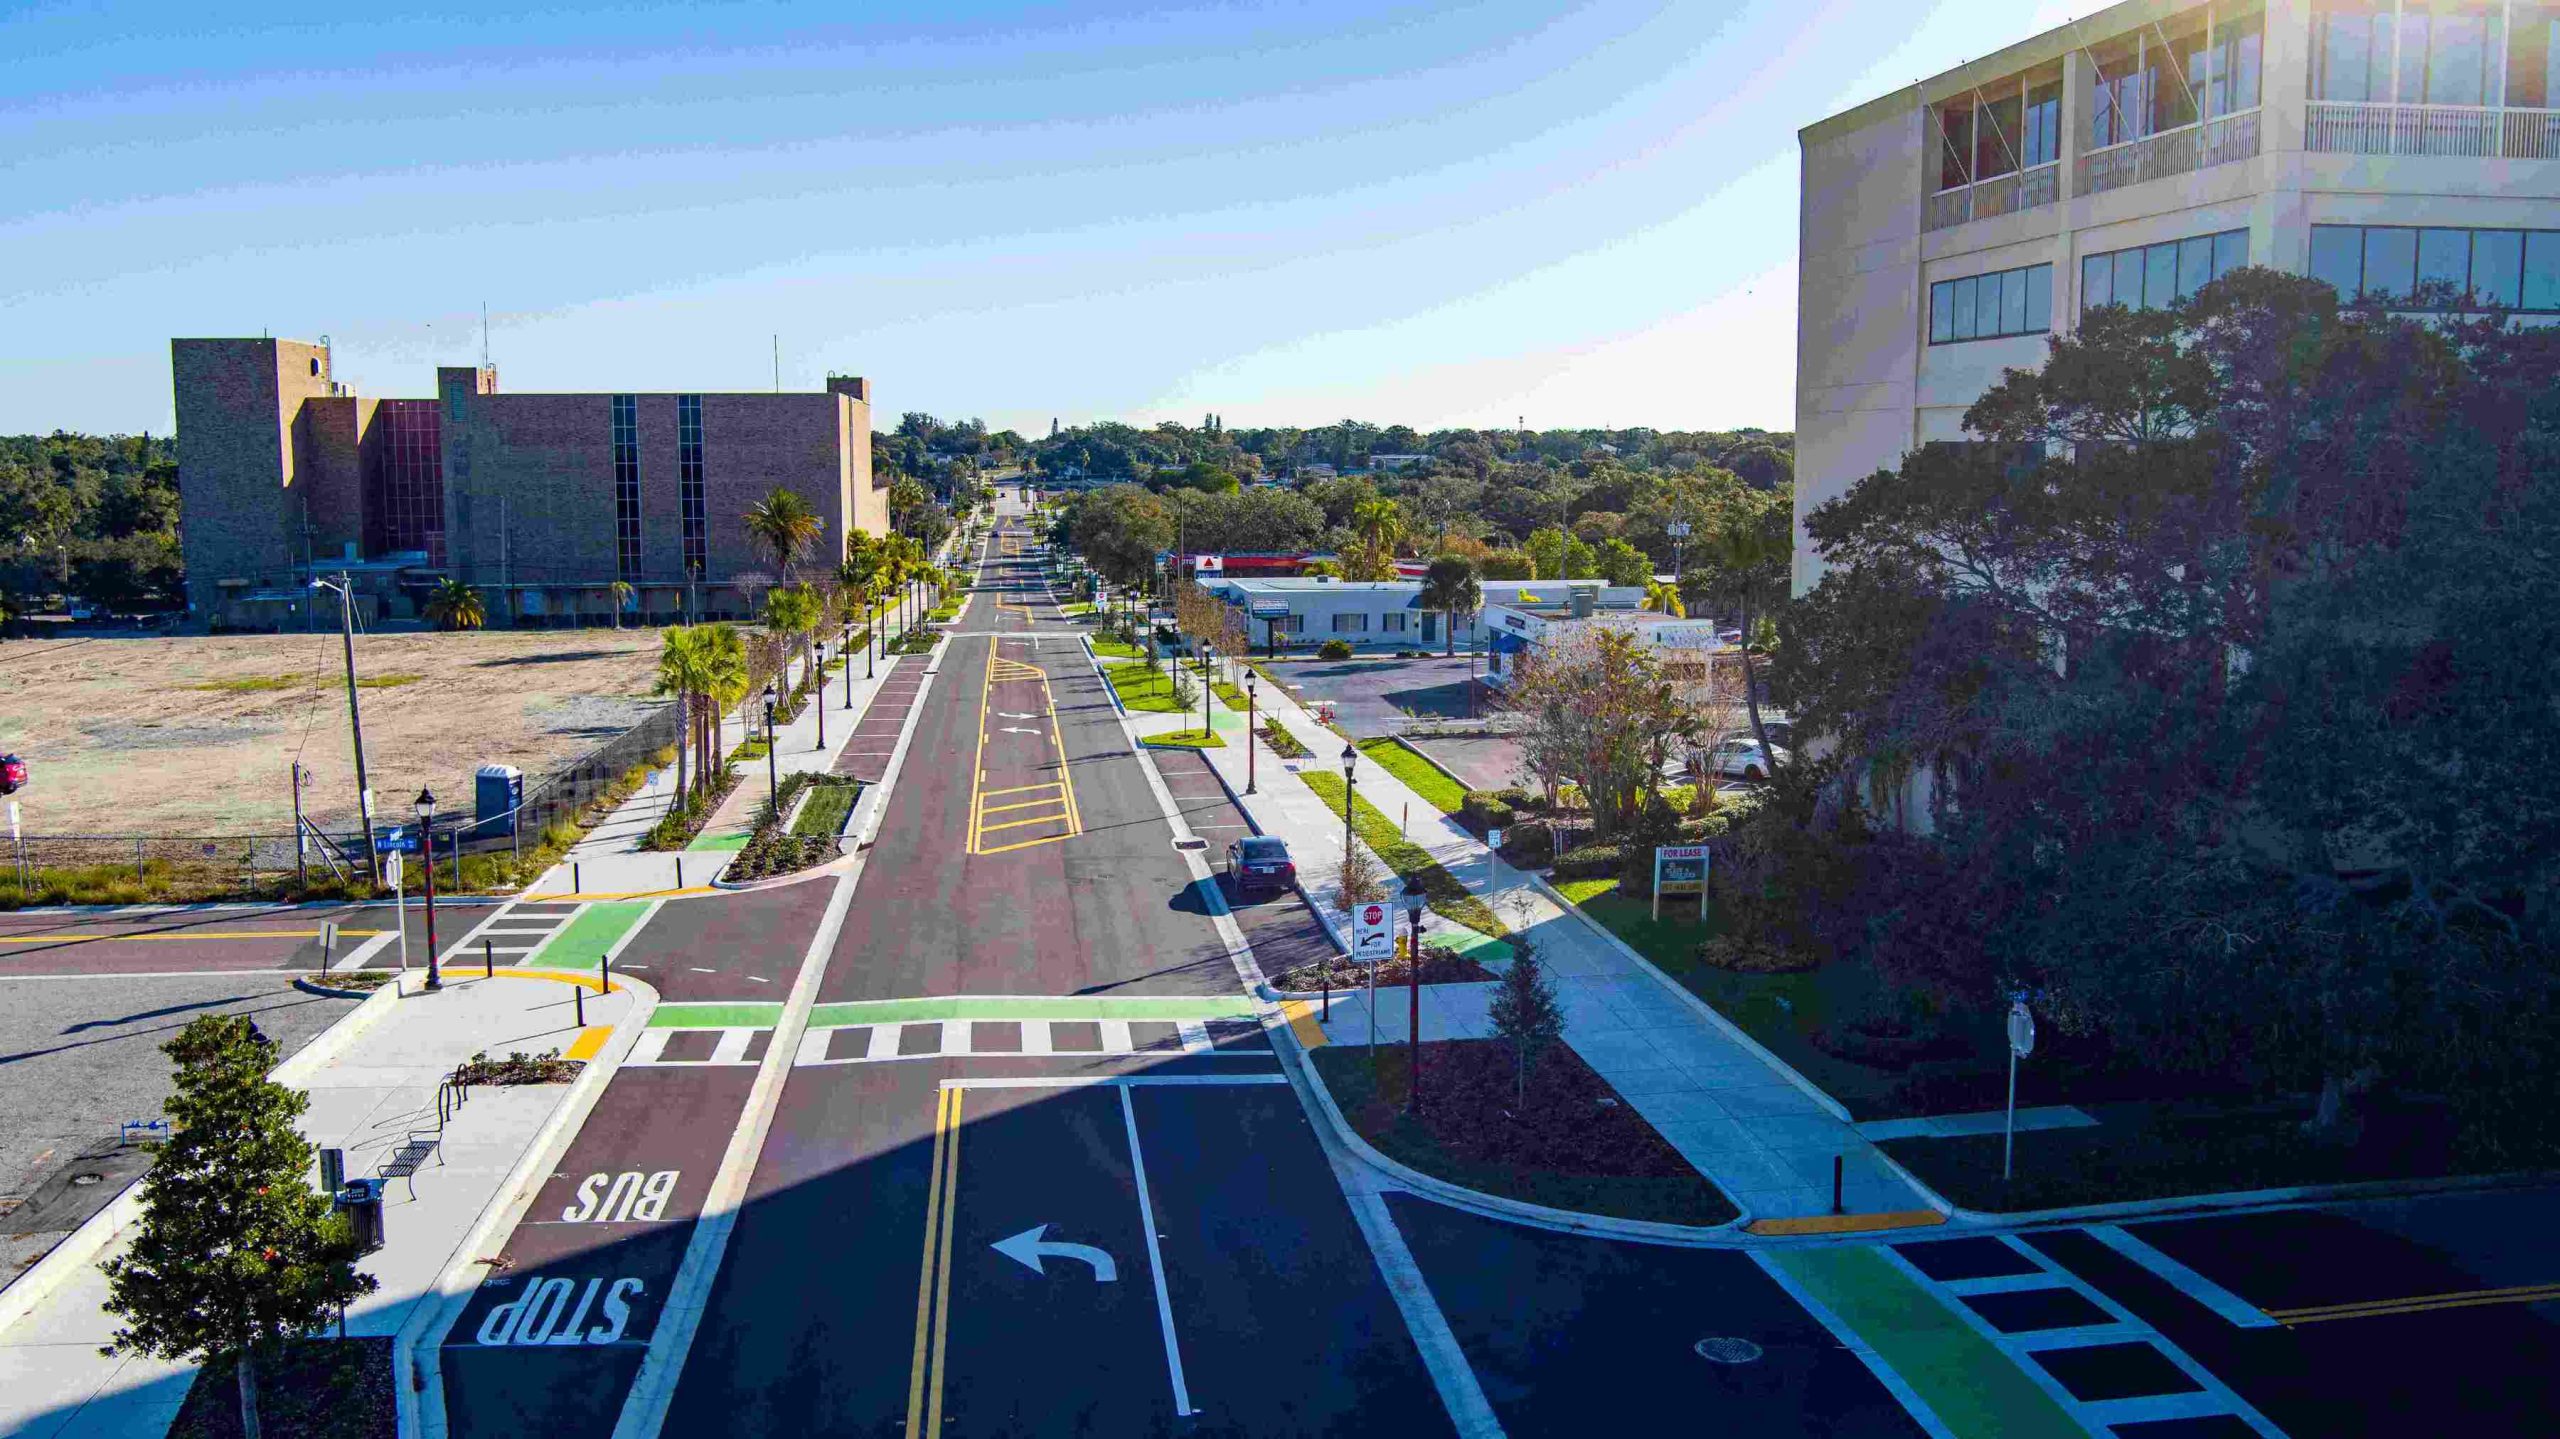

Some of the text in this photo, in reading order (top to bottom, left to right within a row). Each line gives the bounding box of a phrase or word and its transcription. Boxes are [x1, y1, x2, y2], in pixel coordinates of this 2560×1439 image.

[1664, 848, 1701, 857] FOR LEASE
[1364, 911, 1382, 920] STOP
[561, 1170, 681, 1223] BUS
[476, 1277, 645, 1346] STOP
